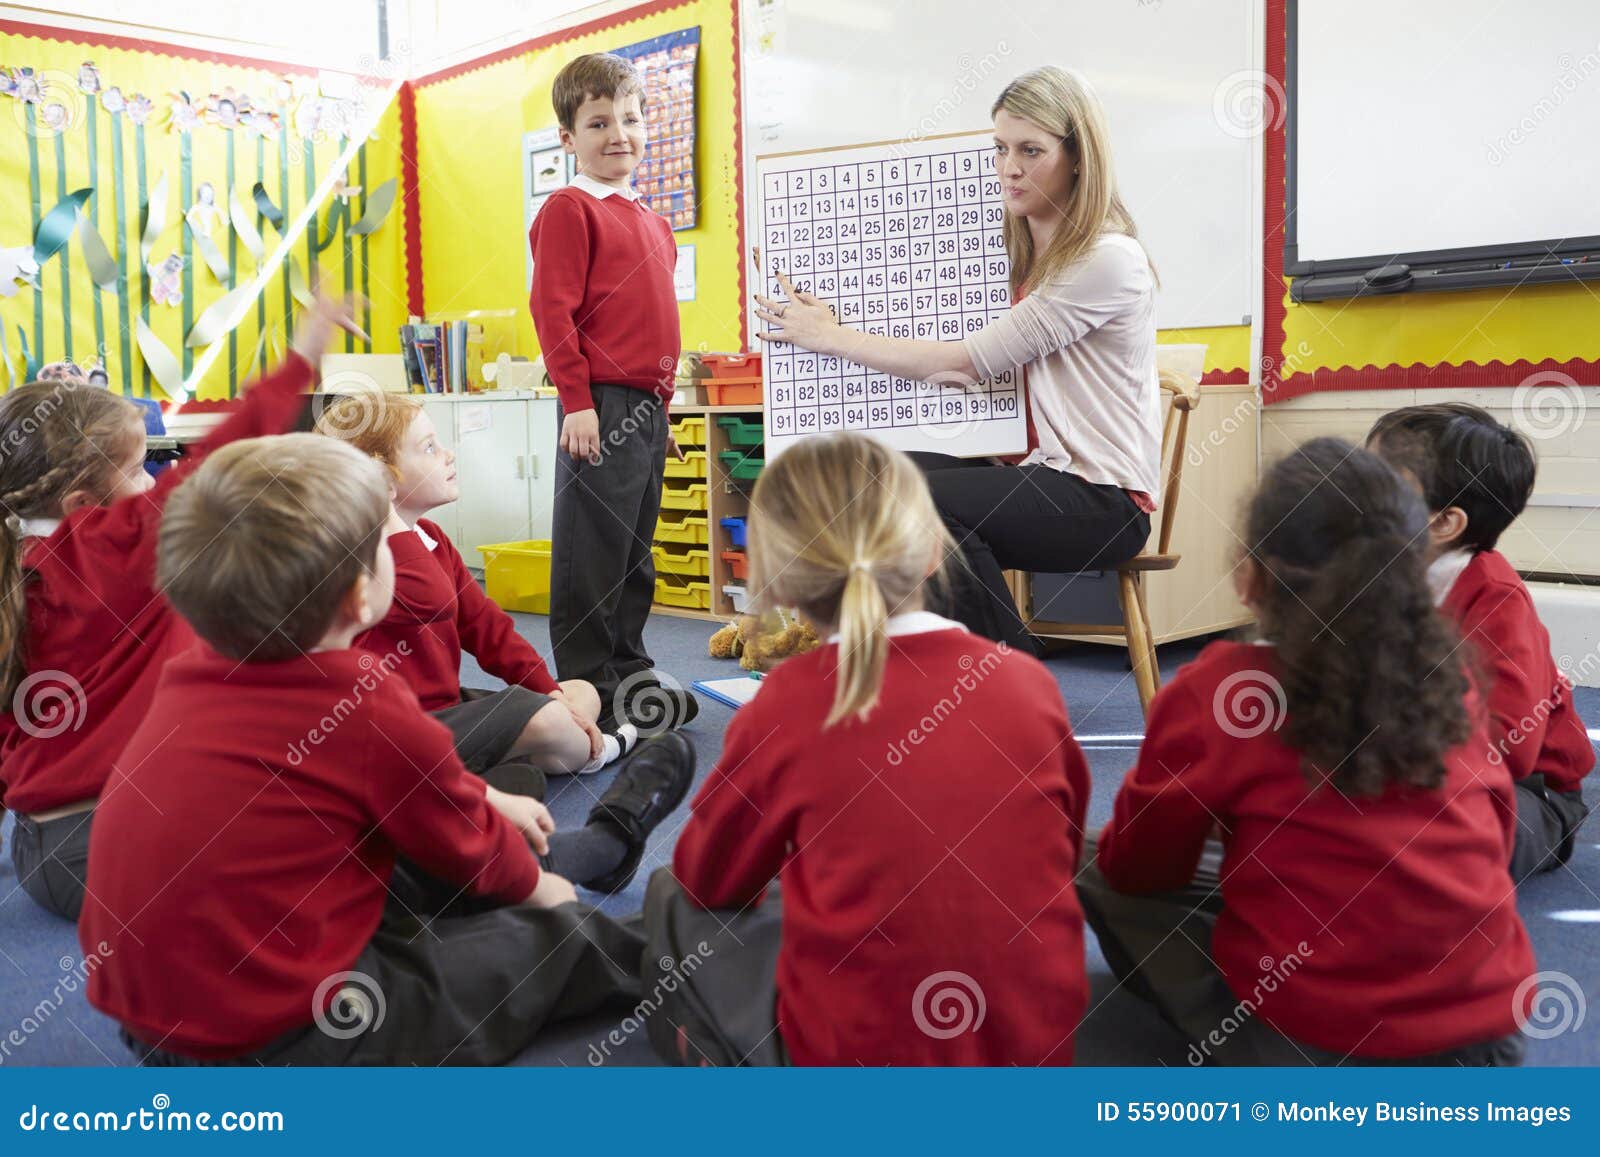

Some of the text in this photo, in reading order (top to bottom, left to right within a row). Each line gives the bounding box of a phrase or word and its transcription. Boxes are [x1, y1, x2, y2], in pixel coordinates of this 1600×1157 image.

[773, 180, 780, 193] 1
[795, 176, 804, 190] 2
[819, 174, 827, 188] 3
[843, 171, 851, 185] 4
[867, 168, 875, 183] 5
[890, 166, 900, 181] 6
[914, 163, 923, 177] 7
[938, 160, 947, 175] 8
[963, 158, 972, 172] 9
[770, 181, 1002, 218] 11 12 13 14 15 16 17 18 19 20
[771, 207, 1004, 245] 21 22 23 24 25 26 27 28 29 30
[771, 234, 1005, 270] 31 32 33 34 35 36 37 38 39 40
[795, 279, 811, 294] 42
[818, 277, 835, 292] 43
[842, 275, 859, 290] 44
[866, 273, 883, 287] 45
[890, 270, 908, 285] 46
[915, 268, 932, 283] 47
[939, 265, 957, 281] 48
[963, 263, 981, 278] 49
[989, 261, 1006, 277] 50
[843, 301, 860, 317] 54
[867, 299, 885, 315] 55
[891, 297, 909, 312] 56
[916, 295, 933, 310] 57
[941, 292, 958, 308] 58
[965, 290, 983, 306] 59
[990, 287, 1008, 303] 60
[893, 323, 910, 339] 66
[917, 321, 934, 337] 67
[941, 319, 959, 335] 68
[966, 317, 984, 333] 69
[775, 361, 789, 375] 71
[797, 359, 814, 374] 72
[821, 356, 838, 372] 73
[775, 388, 790, 403] 81
[798, 385, 815, 401] 82
[822, 383, 839, 399] 83
[846, 381, 863, 397] 84
[870, 379, 888, 395] 85
[895, 378, 912, 393] 86
[776, 397, 1015, 429] 91 92 93 94 95 96 97 98 99 100
